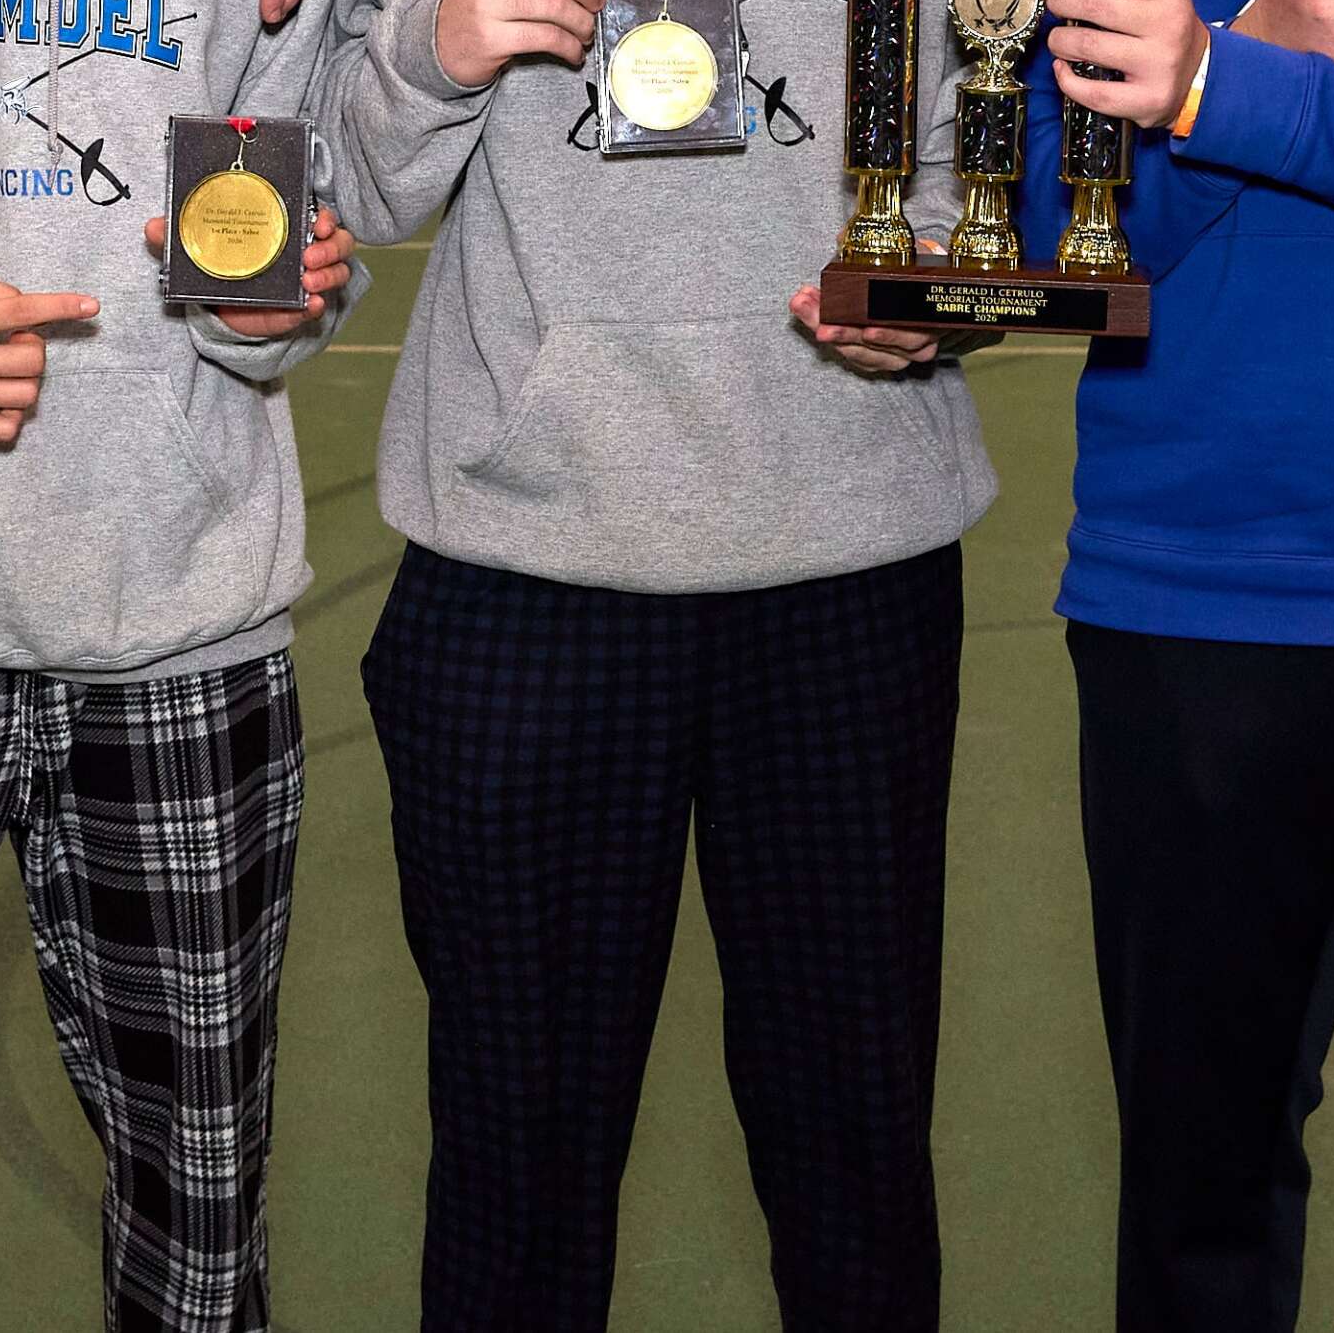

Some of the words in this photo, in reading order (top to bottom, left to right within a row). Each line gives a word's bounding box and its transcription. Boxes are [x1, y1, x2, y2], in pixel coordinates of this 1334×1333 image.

[930, 286, 946, 294] DR.
[949, 286, 988, 296] GERALD
[990, 288, 996, 297] I.
[998, 288, 1044, 298] CETRULO
[926, 294, 977, 304] MEMORIAL
[979, 296, 1048, 307] TOURNAMENT
[936, 303, 971, 313] SABRE
[974, 305, 1037, 316] CHAMPIONS
[974, 314, 998, 322] 2026
